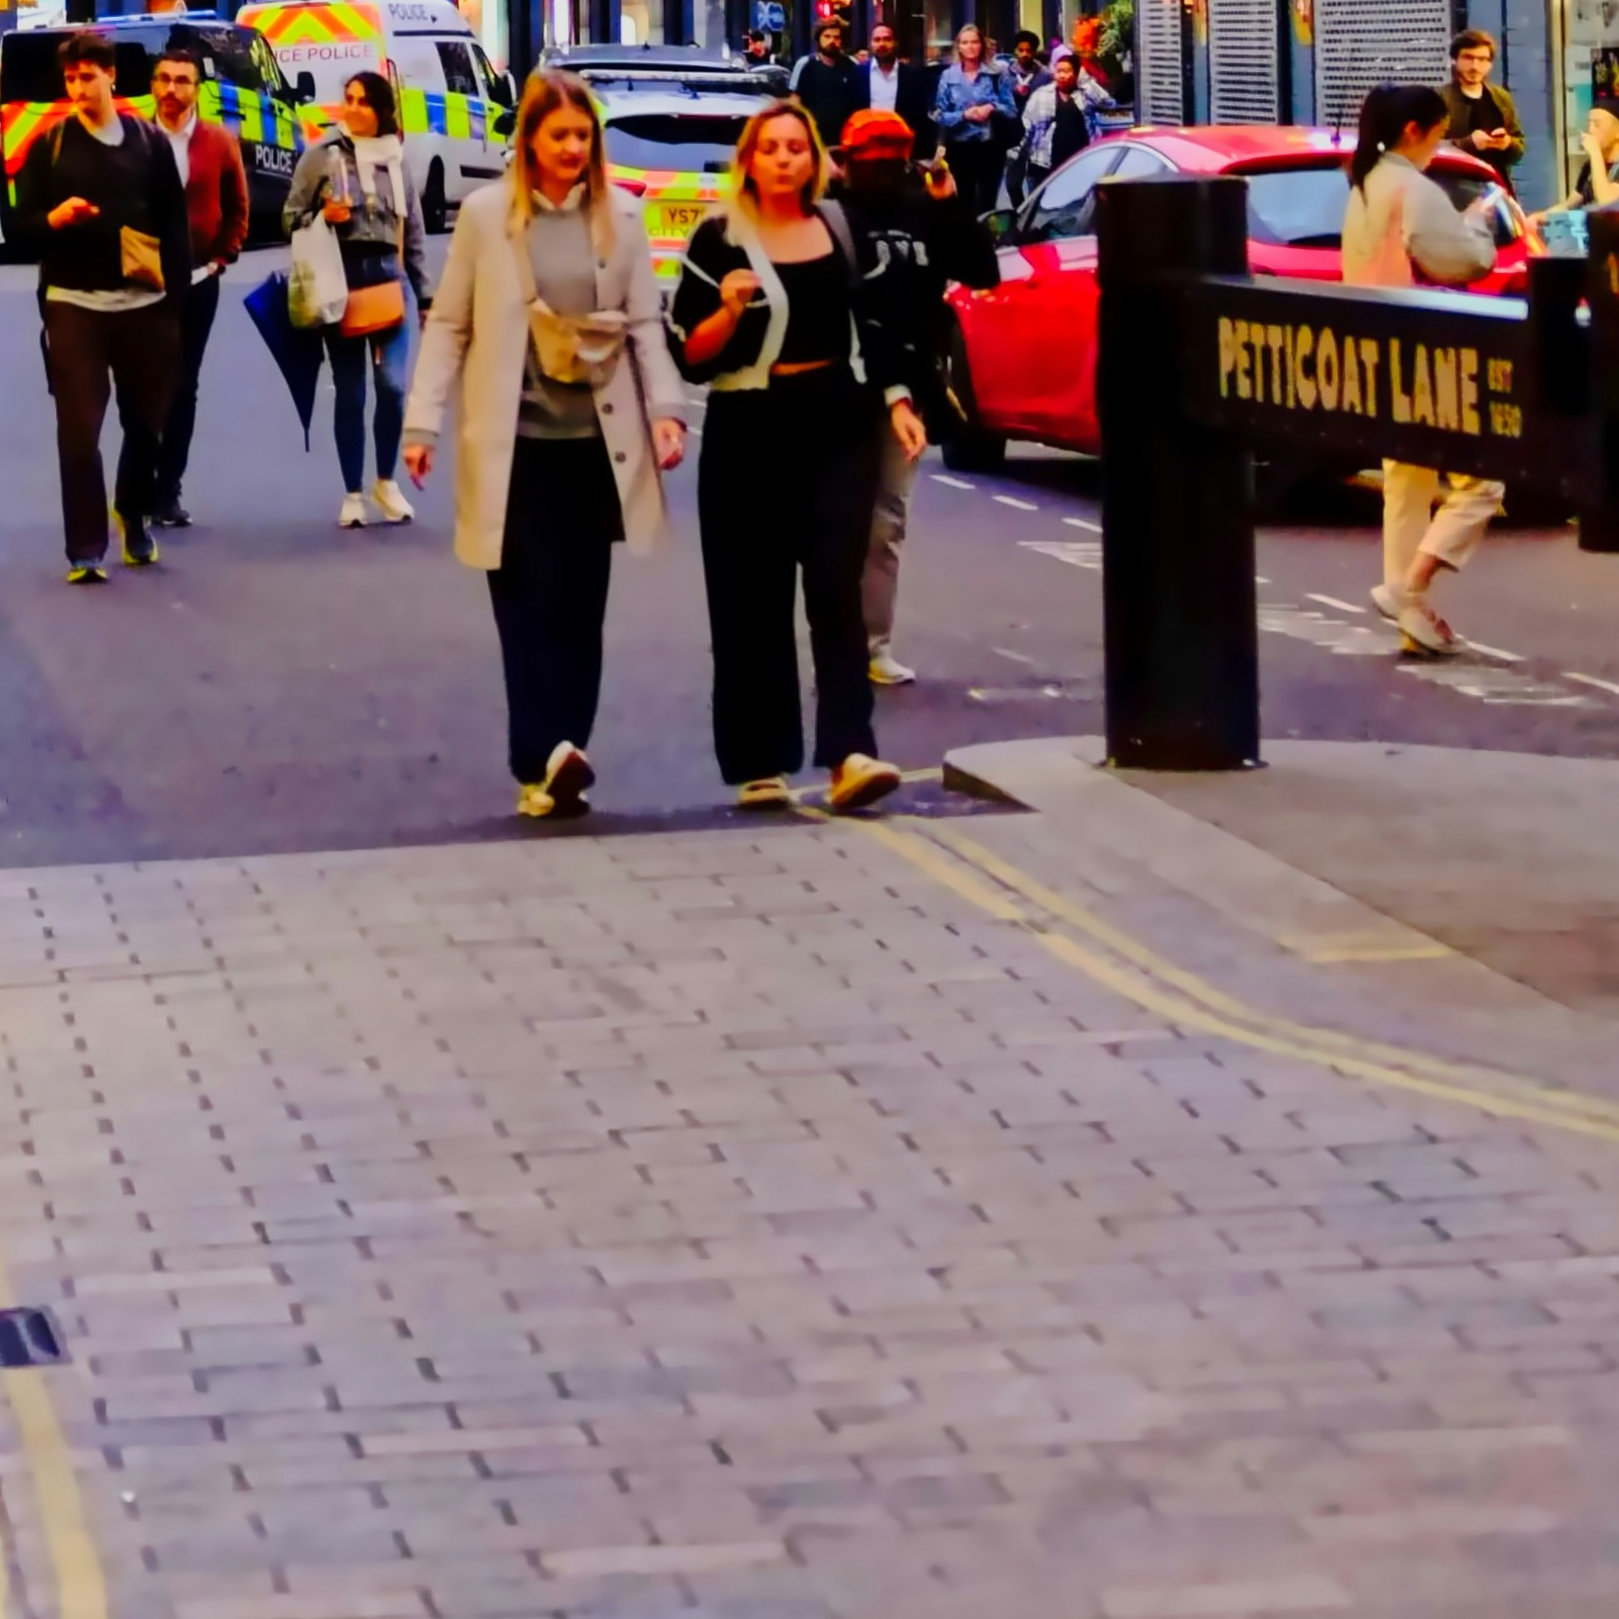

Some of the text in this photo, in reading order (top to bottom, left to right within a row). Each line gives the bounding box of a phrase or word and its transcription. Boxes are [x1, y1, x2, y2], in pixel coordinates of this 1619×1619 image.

[387, 3, 429, 21] POLICE
[307, 43, 374, 62] POLICE
[254, 144, 294, 175] POLICE
[667, 208, 703, 225] YS7
[1218, 315, 1481, 437] PETTICOAT LANE
